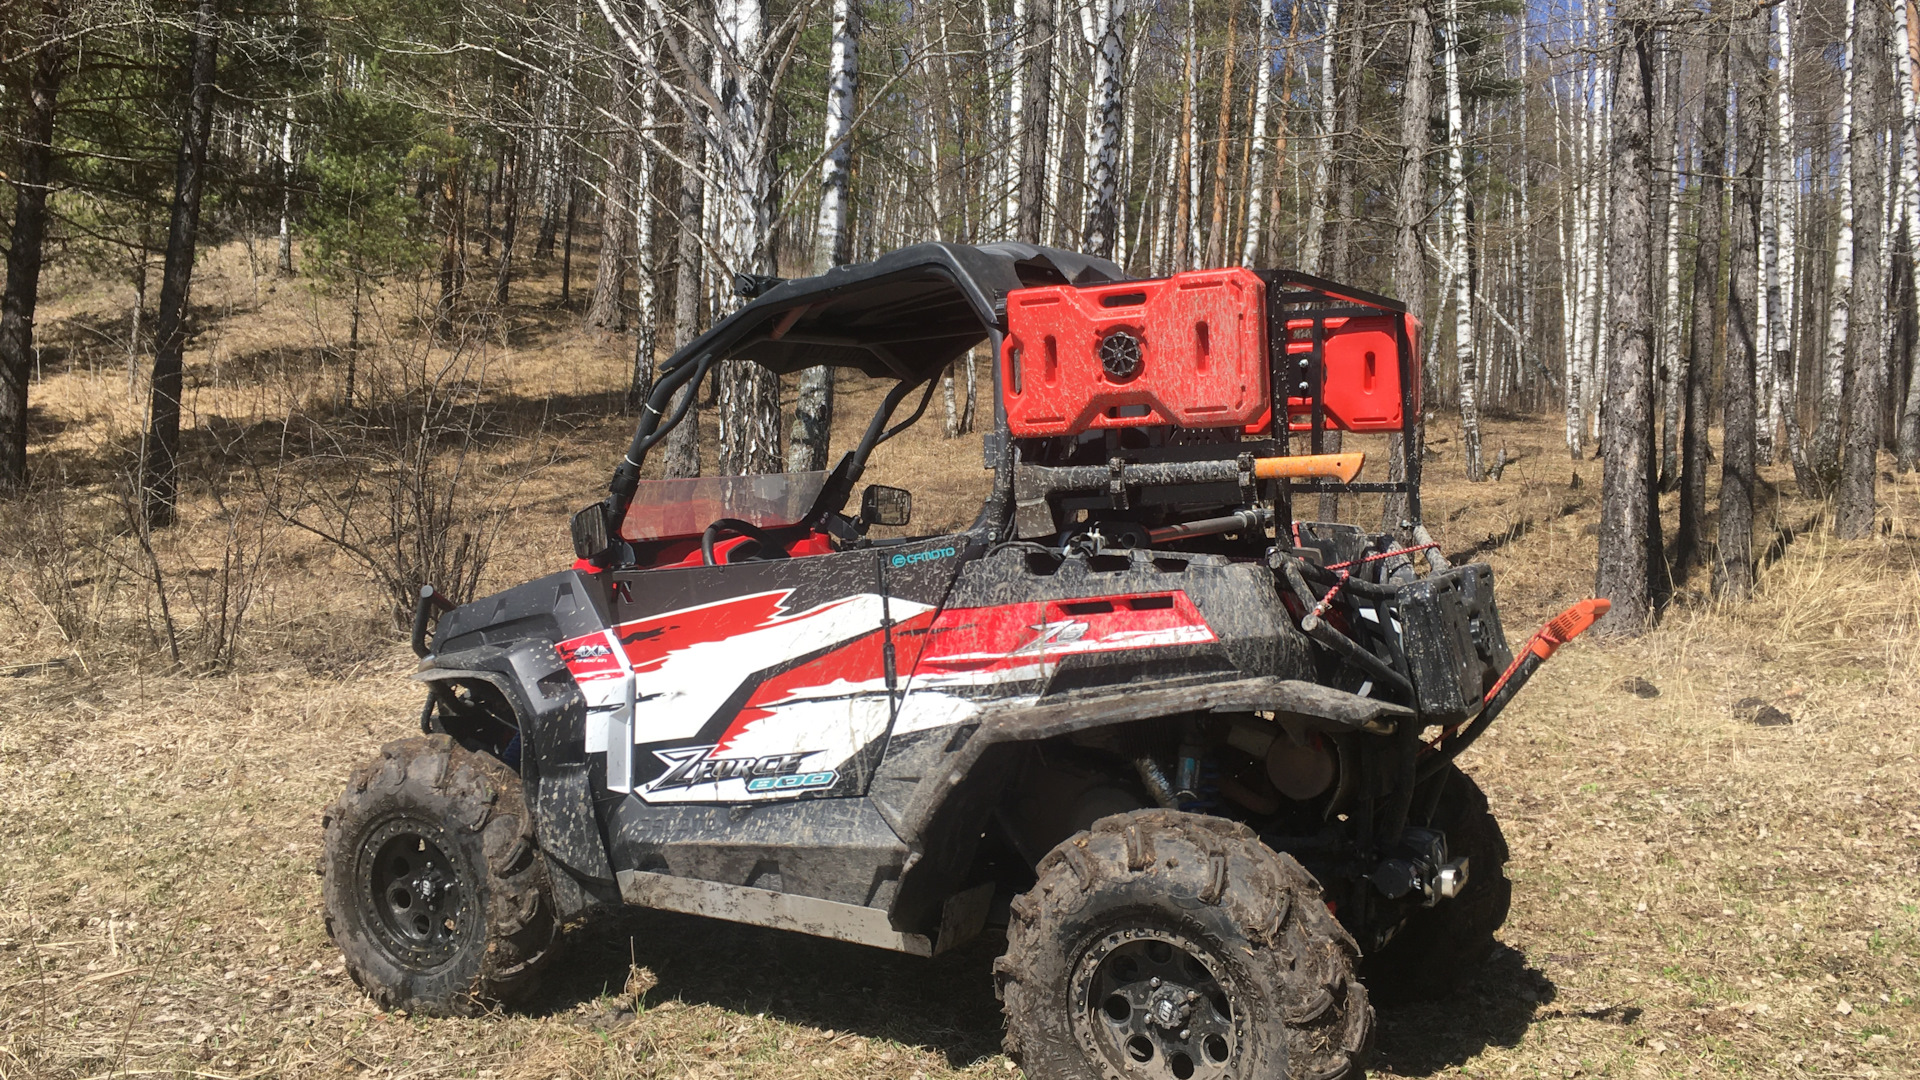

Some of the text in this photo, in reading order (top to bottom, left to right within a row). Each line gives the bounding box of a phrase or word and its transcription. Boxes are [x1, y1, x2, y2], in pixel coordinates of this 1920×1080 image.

[906, 546, 956, 564] CFMOTO
[646, 744, 826, 793] ZFORCE
[747, 772, 835, 791] 800
